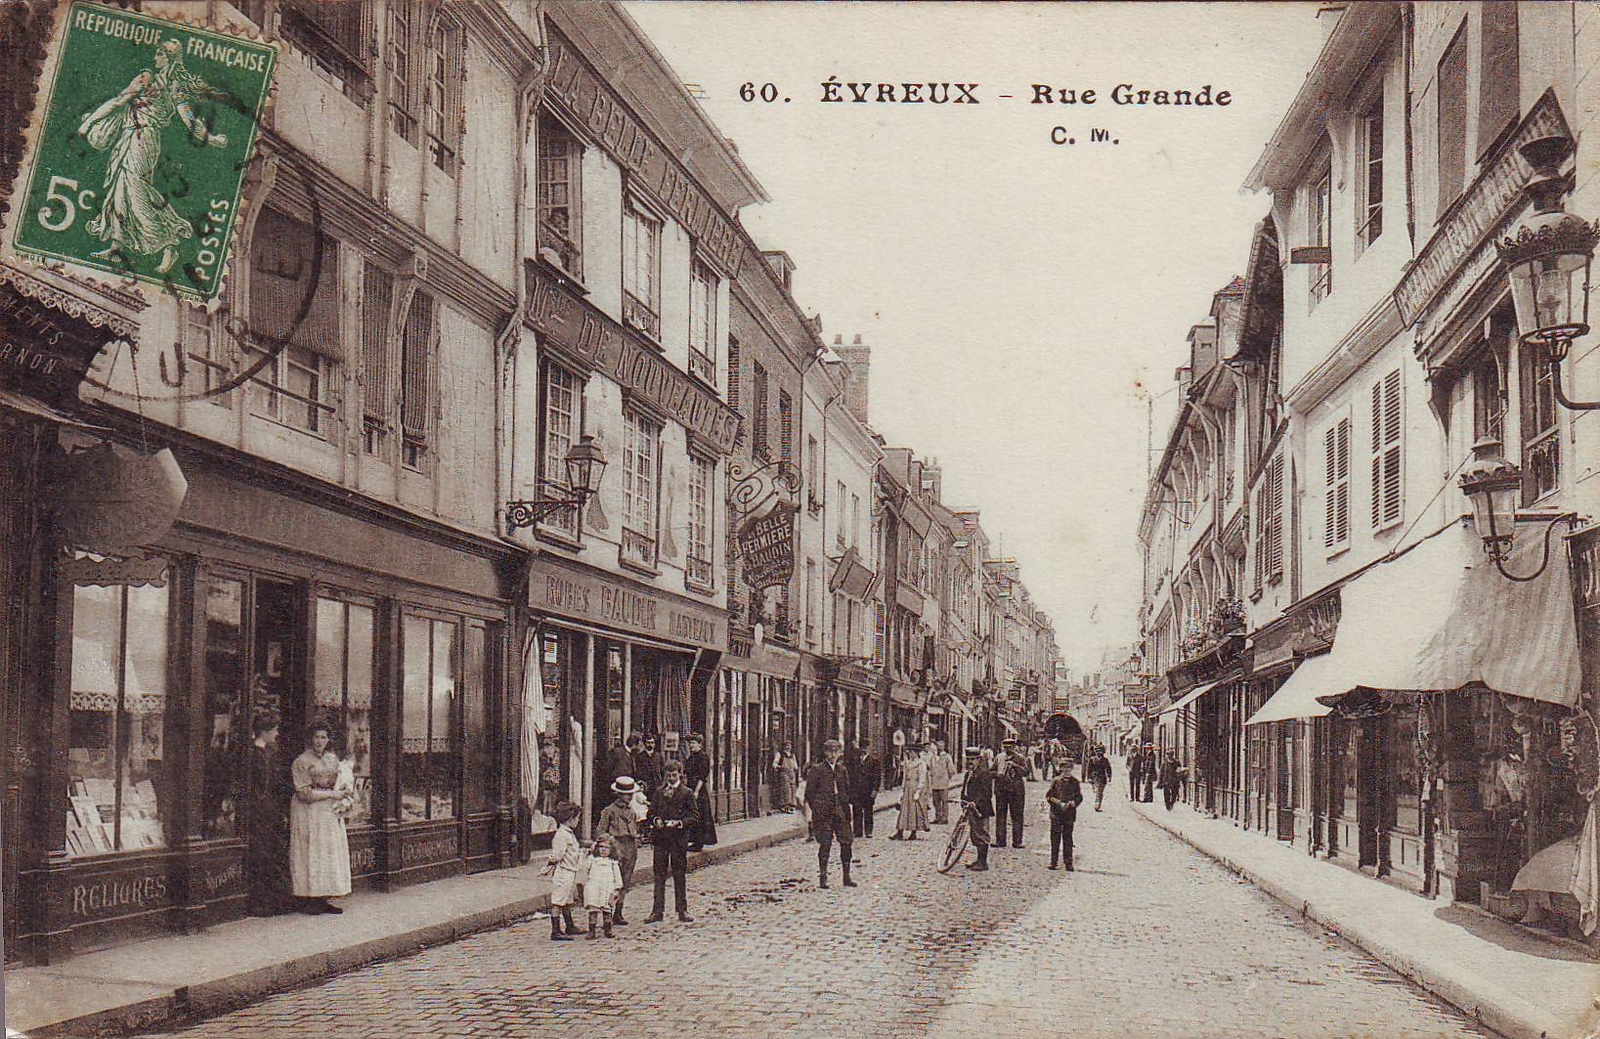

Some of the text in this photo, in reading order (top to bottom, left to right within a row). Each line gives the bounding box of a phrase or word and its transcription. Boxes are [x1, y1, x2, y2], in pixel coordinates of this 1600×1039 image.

[75, 10, 266, 74] REPUBLIQUE FRANÇAISE
[194, 198, 230, 281] POSTES
[577, 311, 612, 369] DE
[755, 513, 788, 537] BELLE
[546, 575, 591, 614] ROBES
